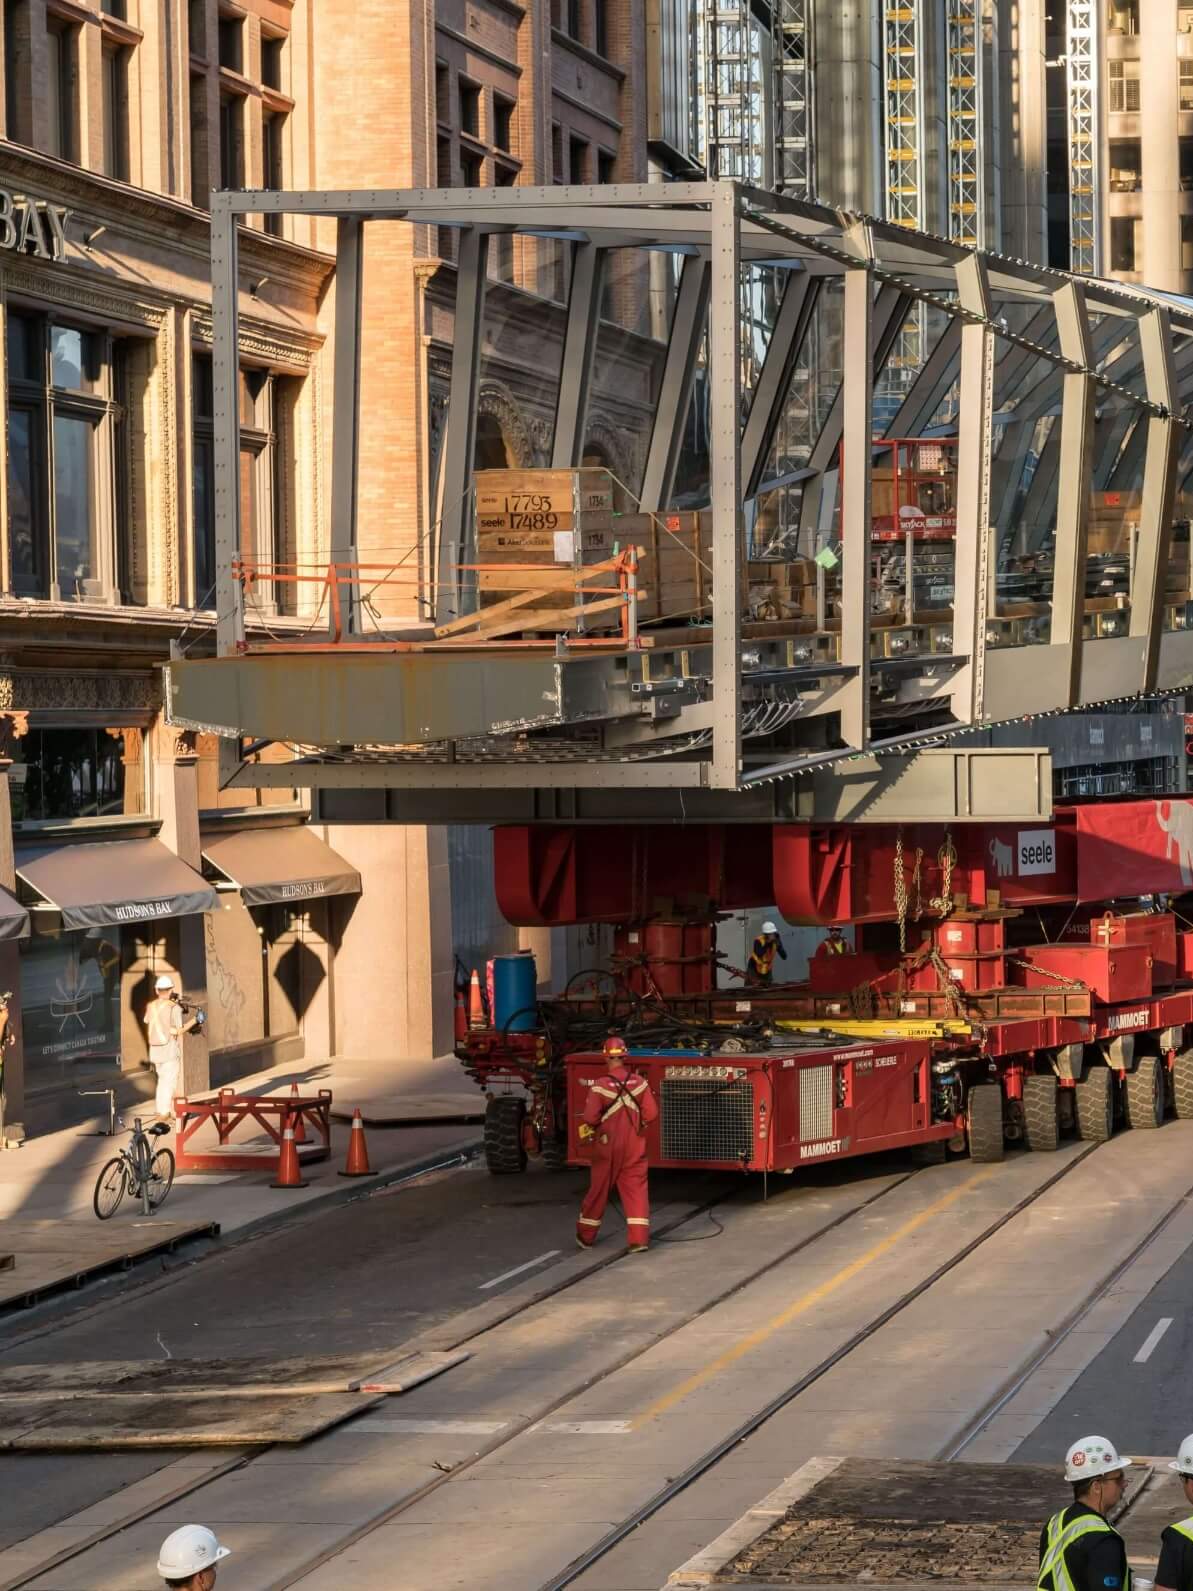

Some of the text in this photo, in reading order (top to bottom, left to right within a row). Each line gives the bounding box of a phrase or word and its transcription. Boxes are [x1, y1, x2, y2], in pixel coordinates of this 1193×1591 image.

[510, 513, 558, 531] 17489
[1021, 839, 1053, 865] seele
[115, 903, 155, 920] HUDSON'S
[1108, 1010, 1150, 1031] MAMMOET
[800, 1139, 841, 1160] MAMMOET
